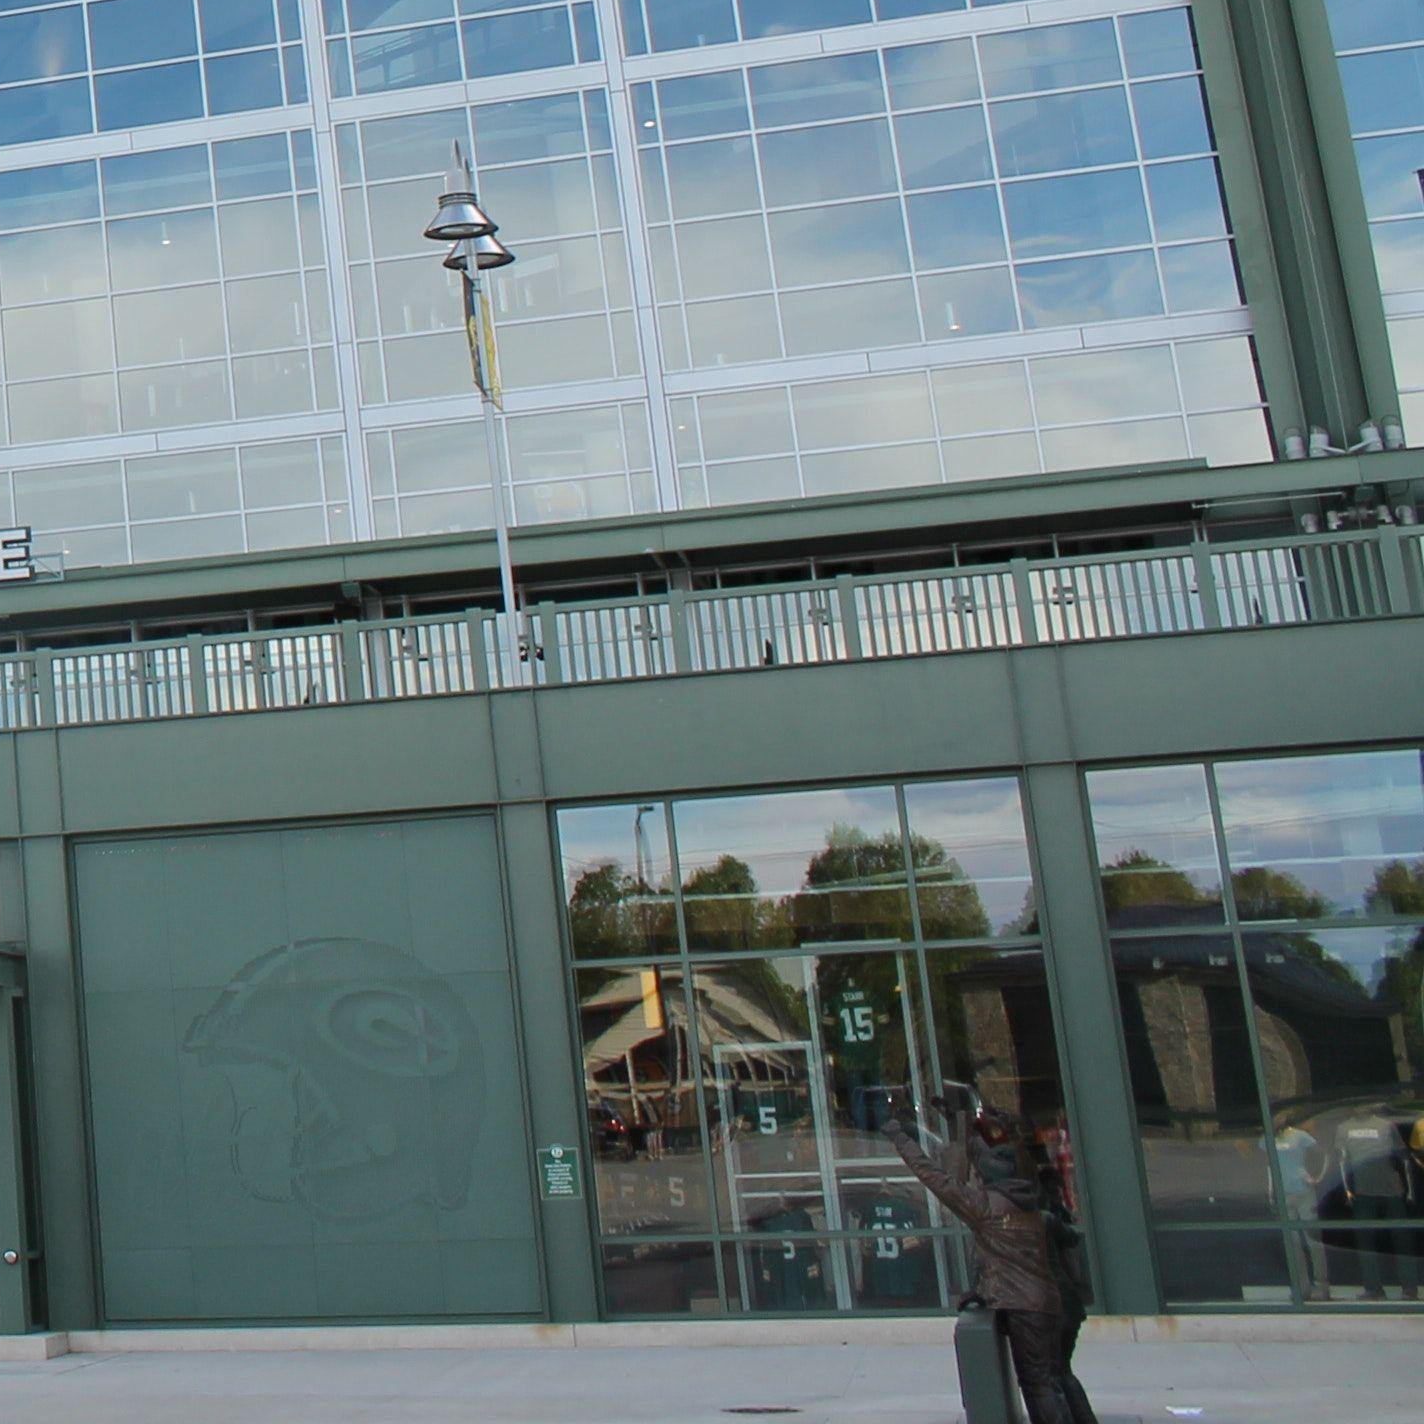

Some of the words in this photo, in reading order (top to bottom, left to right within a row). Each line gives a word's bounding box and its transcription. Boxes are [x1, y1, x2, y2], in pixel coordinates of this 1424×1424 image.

[840, 1006, 874, 1043] 15
[758, 1106, 778, 1135] 5
[669, 1176, 685, 1207] 5
